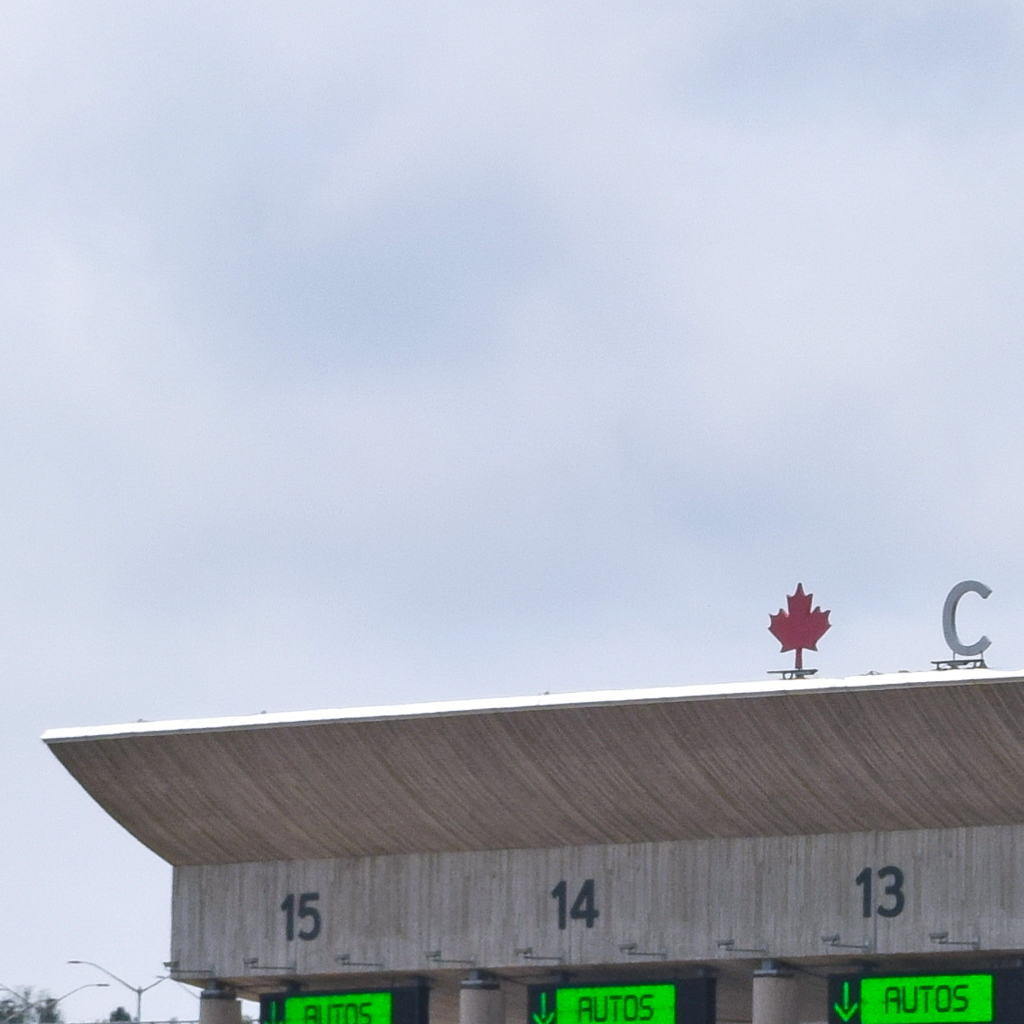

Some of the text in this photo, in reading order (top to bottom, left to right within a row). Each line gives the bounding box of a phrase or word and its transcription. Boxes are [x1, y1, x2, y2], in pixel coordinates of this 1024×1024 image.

[282, 892, 321, 942] 15
[551, 879, 600, 931] 14
[856, 866, 906, 919] 13
[578, 993, 655, 1024] AUTOS
[884, 984, 969, 1014] AUTOS
